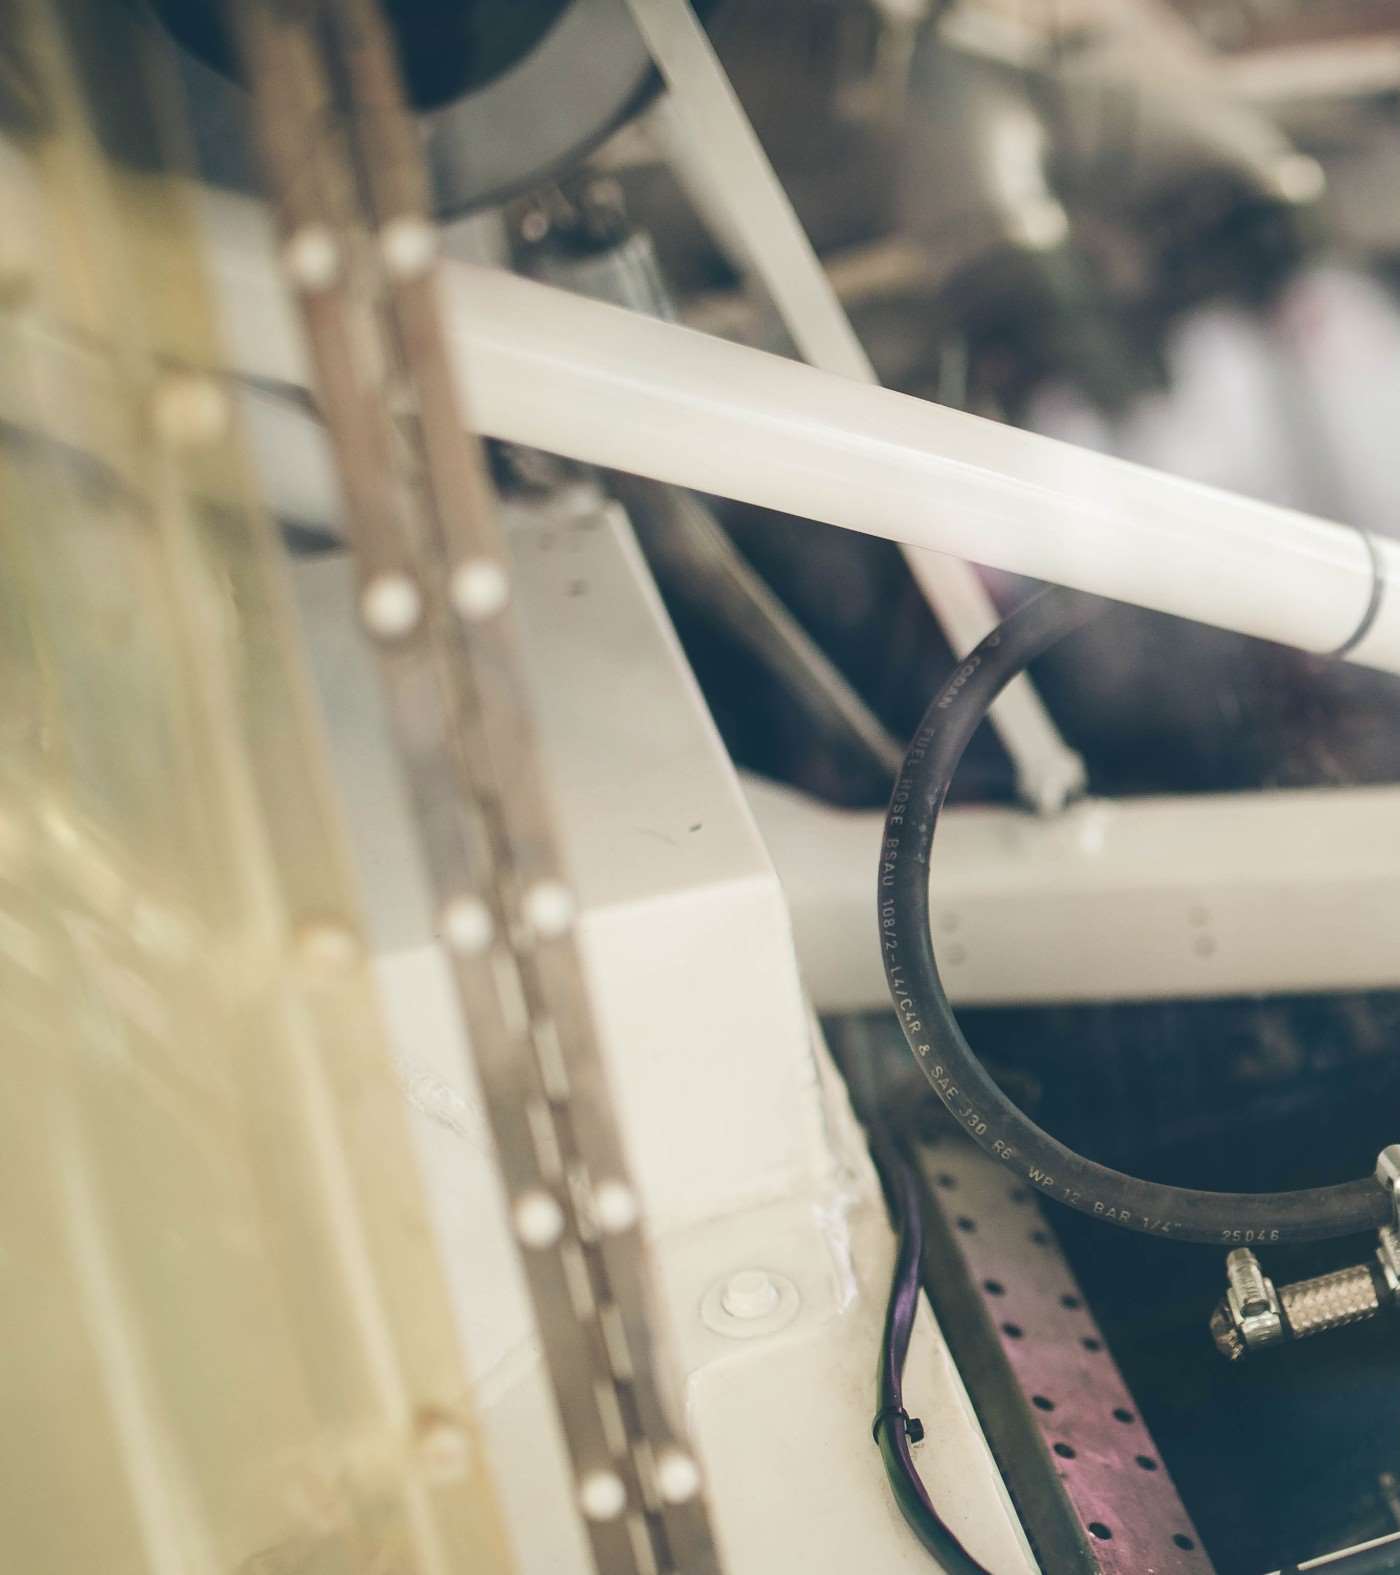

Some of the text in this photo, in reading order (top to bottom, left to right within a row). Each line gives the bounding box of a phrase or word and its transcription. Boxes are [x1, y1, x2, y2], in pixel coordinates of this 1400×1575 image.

[906, 727, 935, 768] FUEL
[890, 778, 913, 826] HOSE
[930, 1065, 960, 1100] SAE
[1027, 1166, 1056, 1188] WP
[1063, 1188, 1081, 1206] 12
[1093, 1201, 1131, 1224] BAR
[1222, 1229, 1281, 1242] 25046
